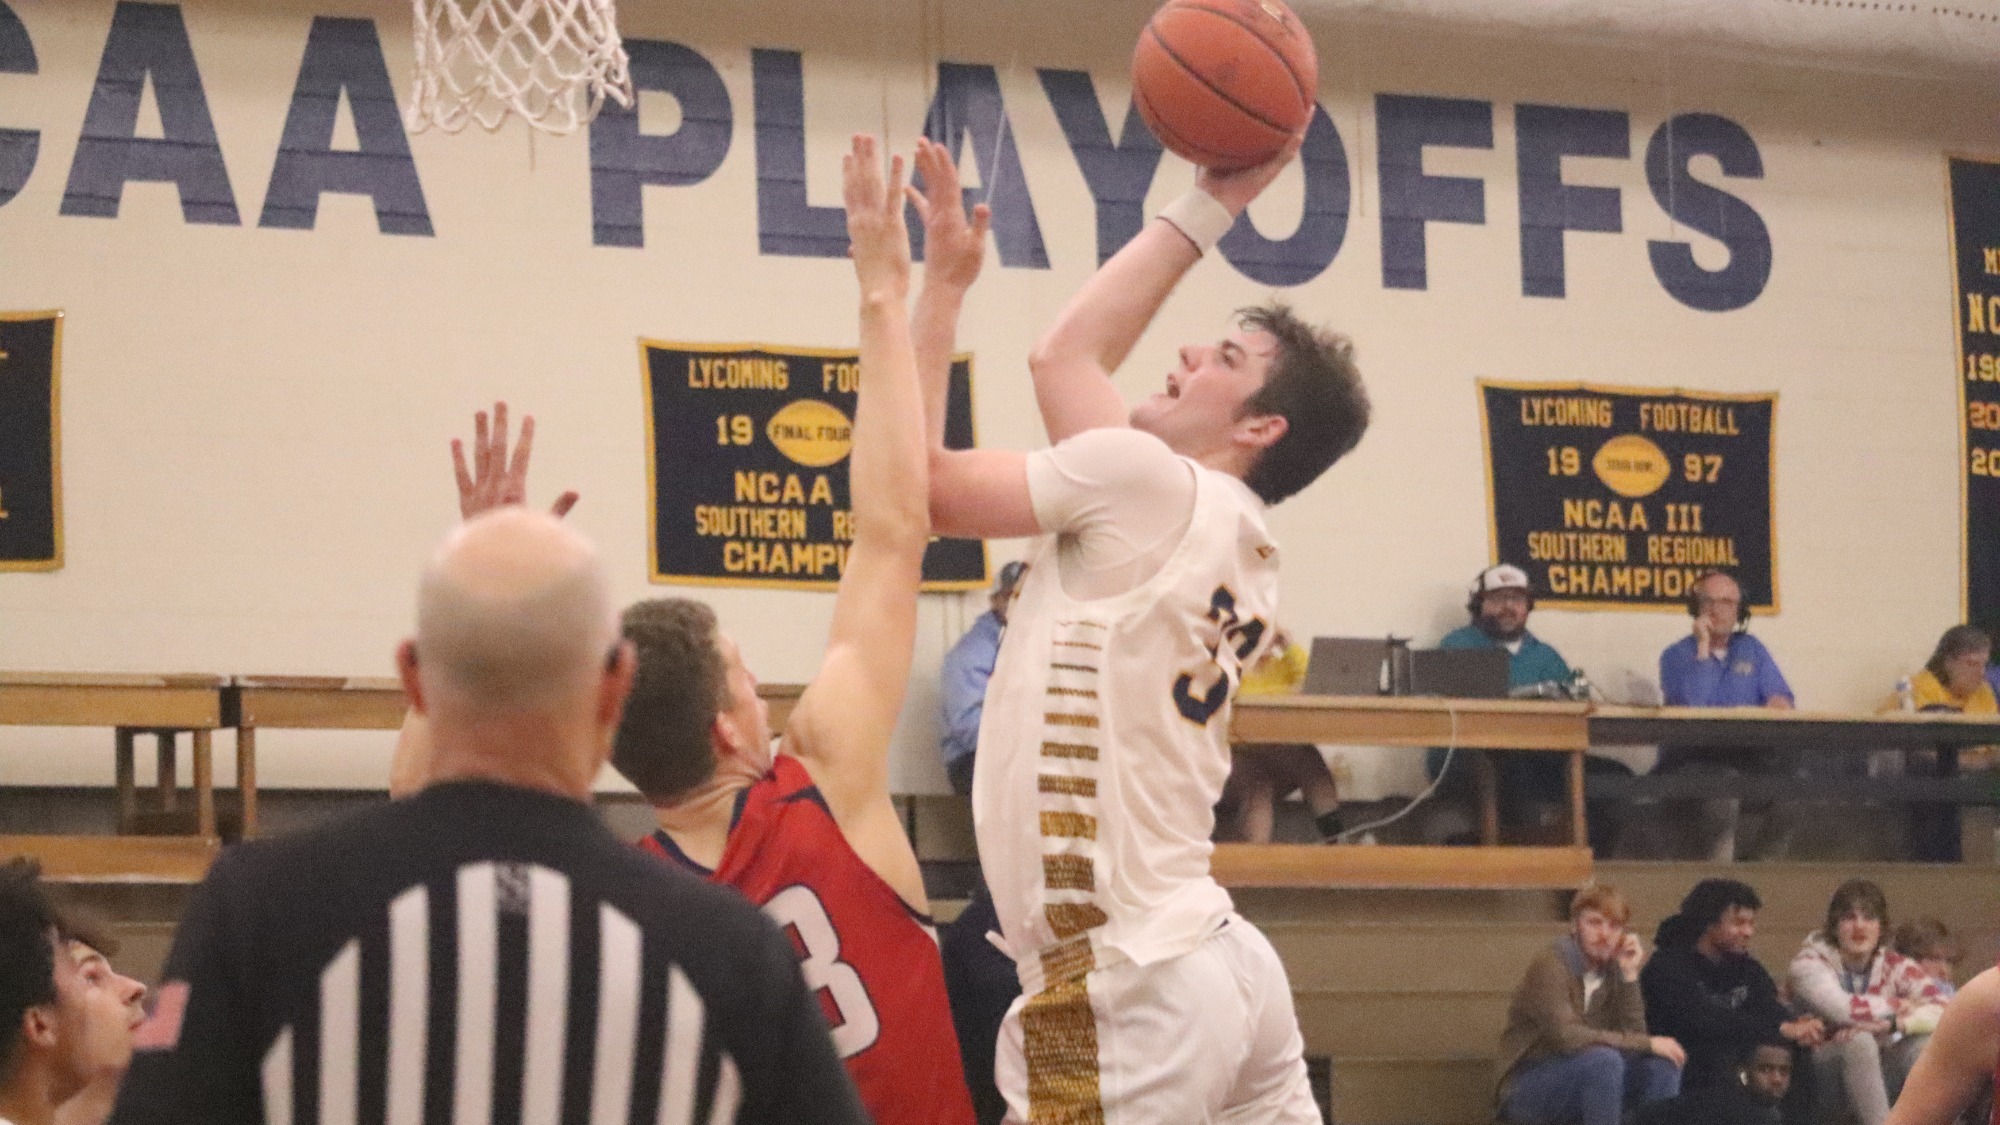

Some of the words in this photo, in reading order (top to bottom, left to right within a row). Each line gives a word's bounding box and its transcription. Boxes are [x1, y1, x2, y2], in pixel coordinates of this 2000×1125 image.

[0, 0, 436, 237] AA
[588, 38, 1774, 312] PLAYOFFS
[1984, 248, 2000, 274] M
[688, 359, 789, 390] LYCOMING
[716, 415, 754, 445] 19
[1521, 398, 1612, 428] LYCOMING
[1640, 402, 1739, 435] FOOTBALL
[1547, 447, 1580, 476] 19
[1683, 454, 1723, 482] 97
[695, 506, 806, 539] SOUTHERN
[1563, 499, 1648, 531] NCAA
[1665, 503, 1702, 531] III
[1528, 531, 1626, 561] SOUTHERN
[1647, 536, 1739, 566] REGIONAL
